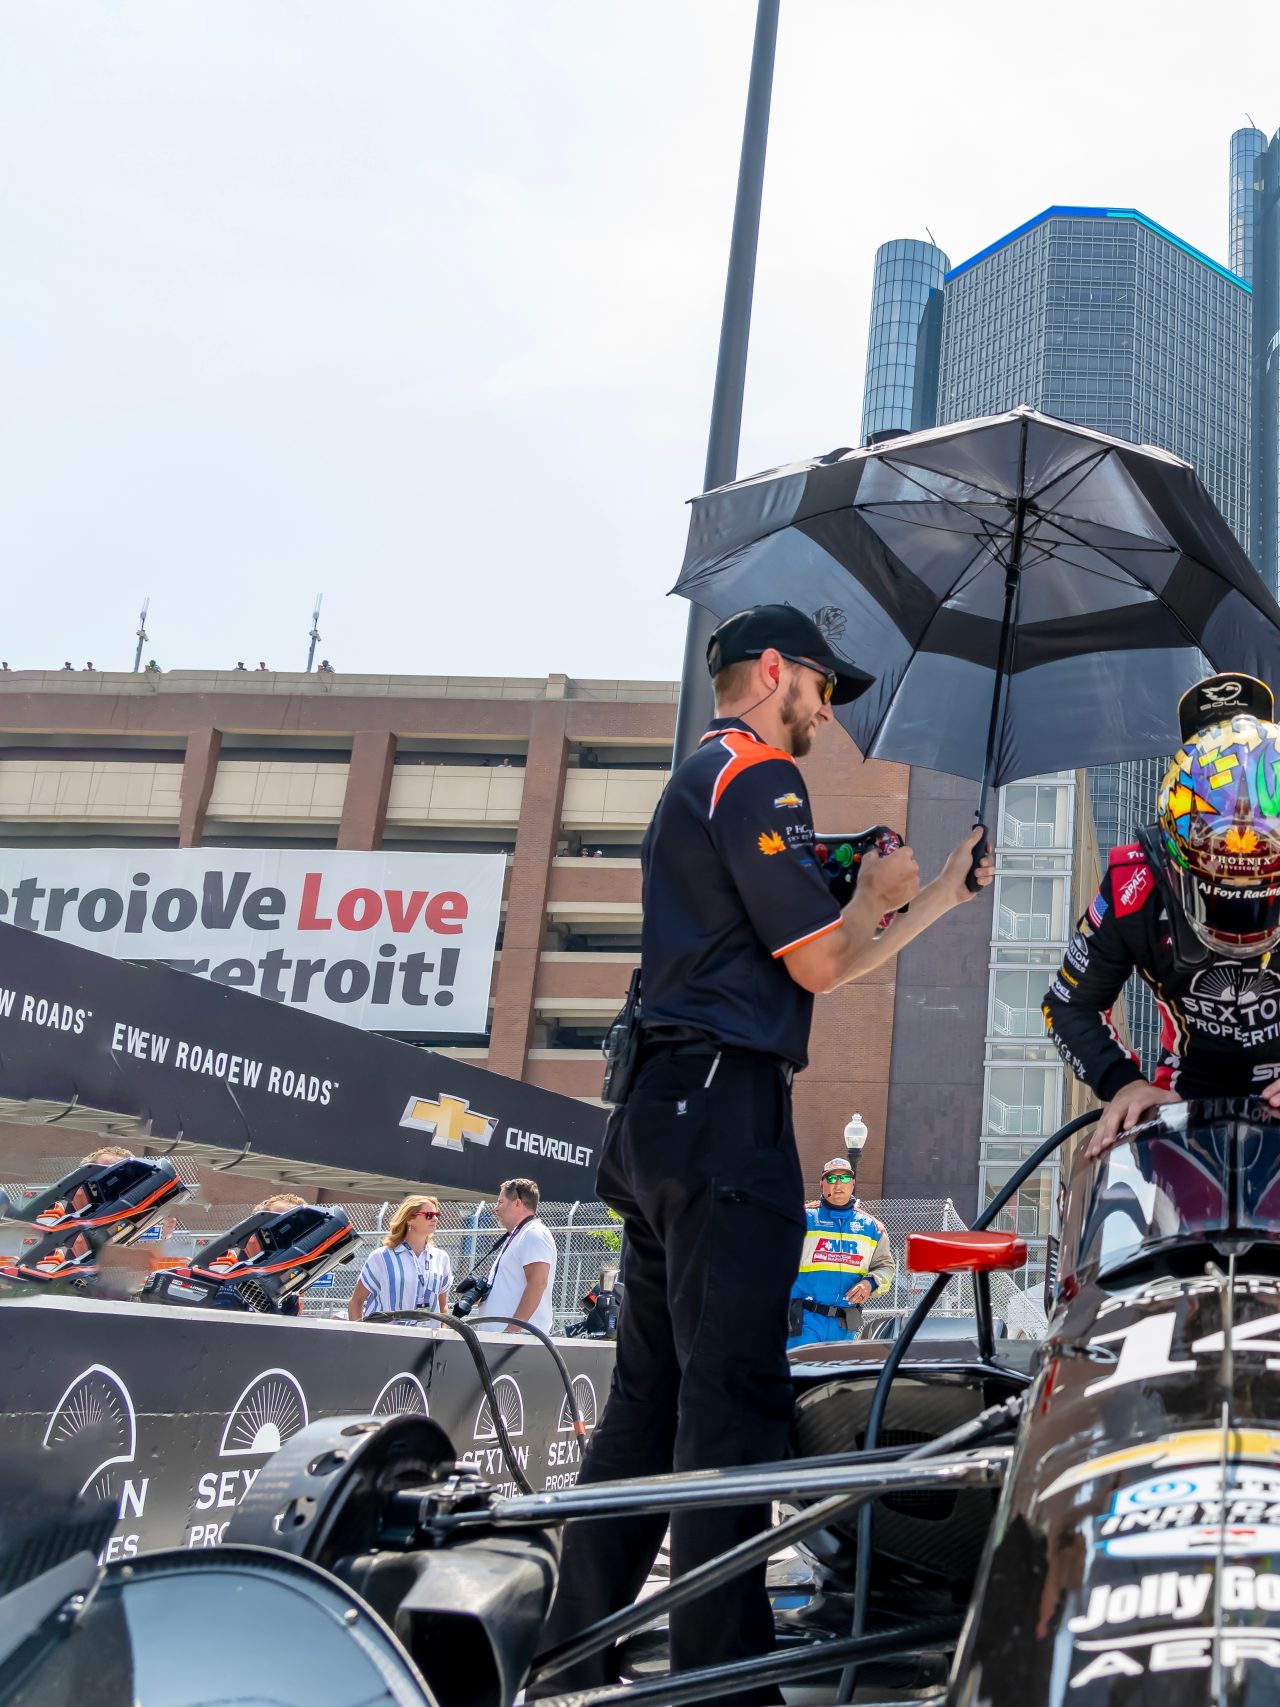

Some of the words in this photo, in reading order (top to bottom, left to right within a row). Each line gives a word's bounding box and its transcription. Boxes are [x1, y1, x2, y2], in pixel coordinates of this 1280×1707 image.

[1210, 854, 1272, 866] PHOENIX
[297, 872, 469, 935] Love
[1120, 867, 1147, 906] IMPACT
[1199, 882, 1211, 895] AJ
[1213, 887, 1242, 900] Foyt
[21, 994, 85, 1035] ROADS
[267, 1065, 332, 1106] ROADS
[505, 1127, 593, 1167] CHEVROLET
[1067, 1571, 1213, 1633] Jolly
